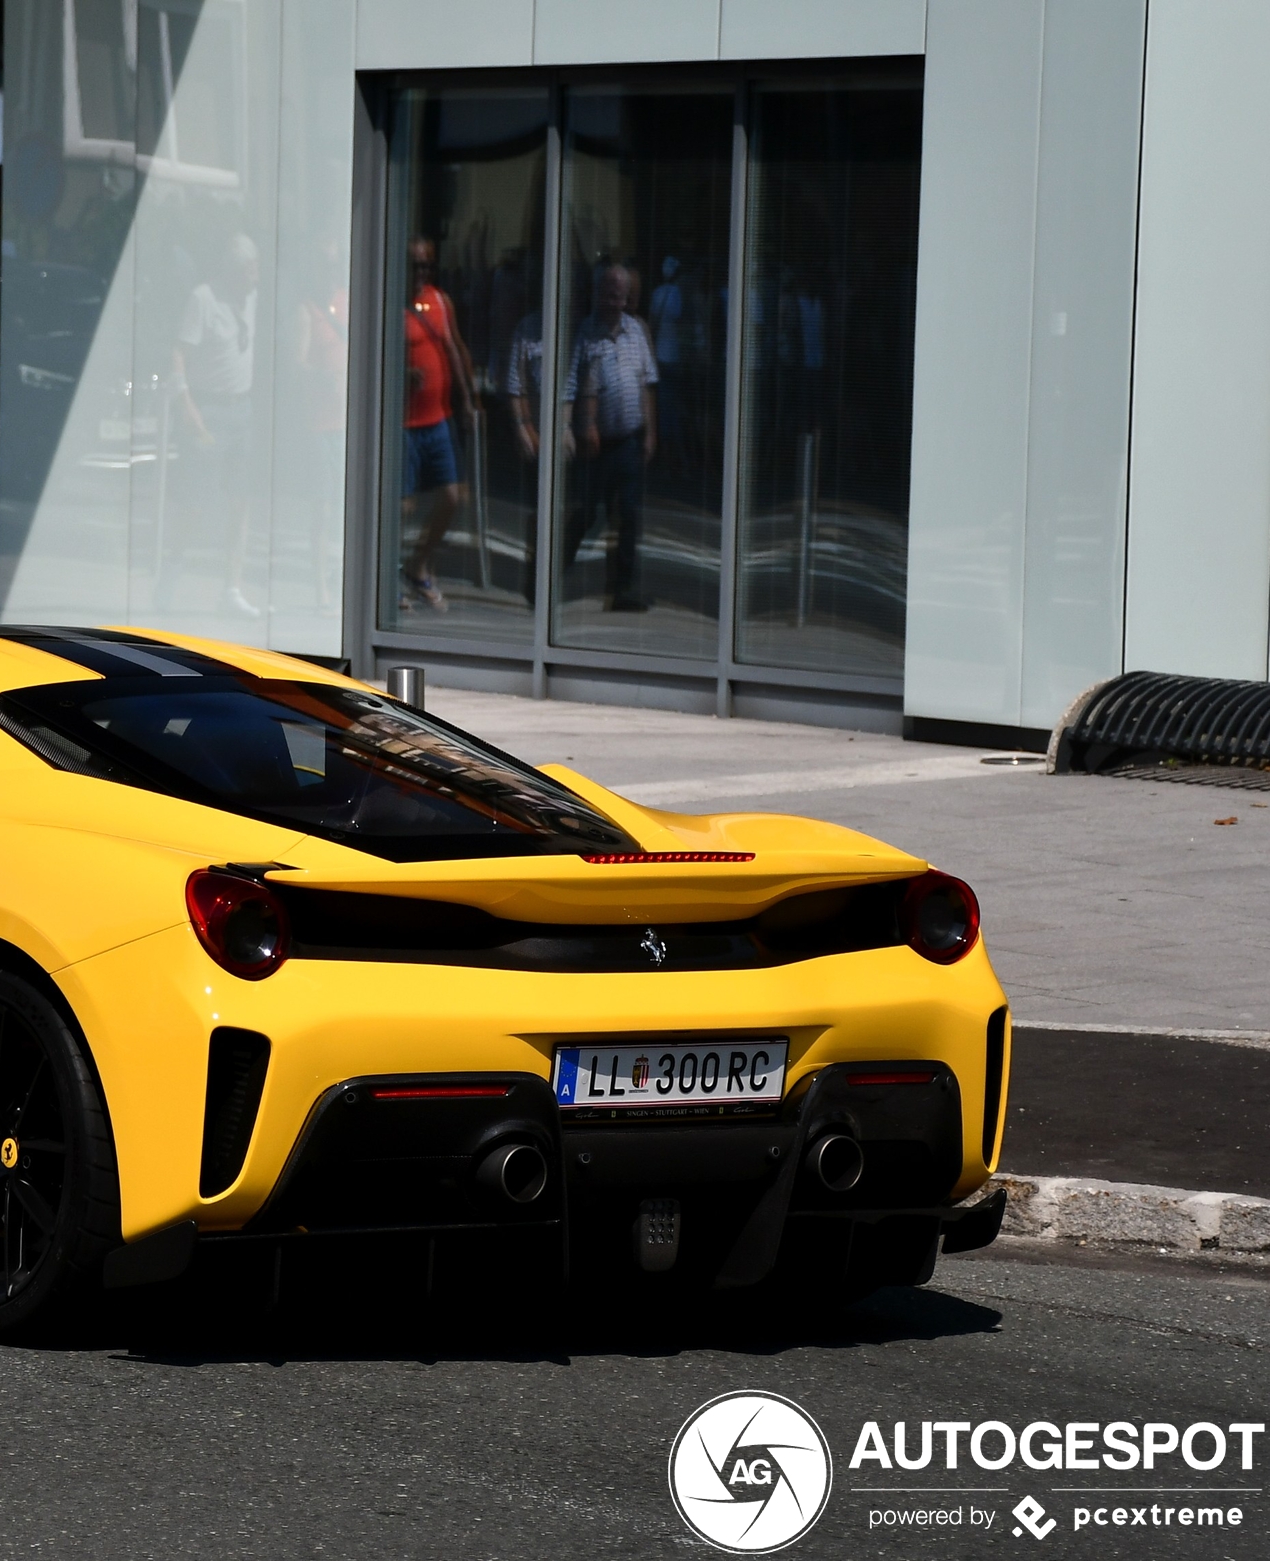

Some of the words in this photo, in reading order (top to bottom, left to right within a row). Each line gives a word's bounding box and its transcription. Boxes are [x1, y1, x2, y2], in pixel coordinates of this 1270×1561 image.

[588, 1055, 626, 1097] LL
[656, 1052, 720, 1095] 300
[727, 1050, 770, 1093] RC
[560, 1083, 571, 1097] A
[655, 1108, 688, 1116] STUTTGART
[694, 1107, 710, 1115] WIEN
